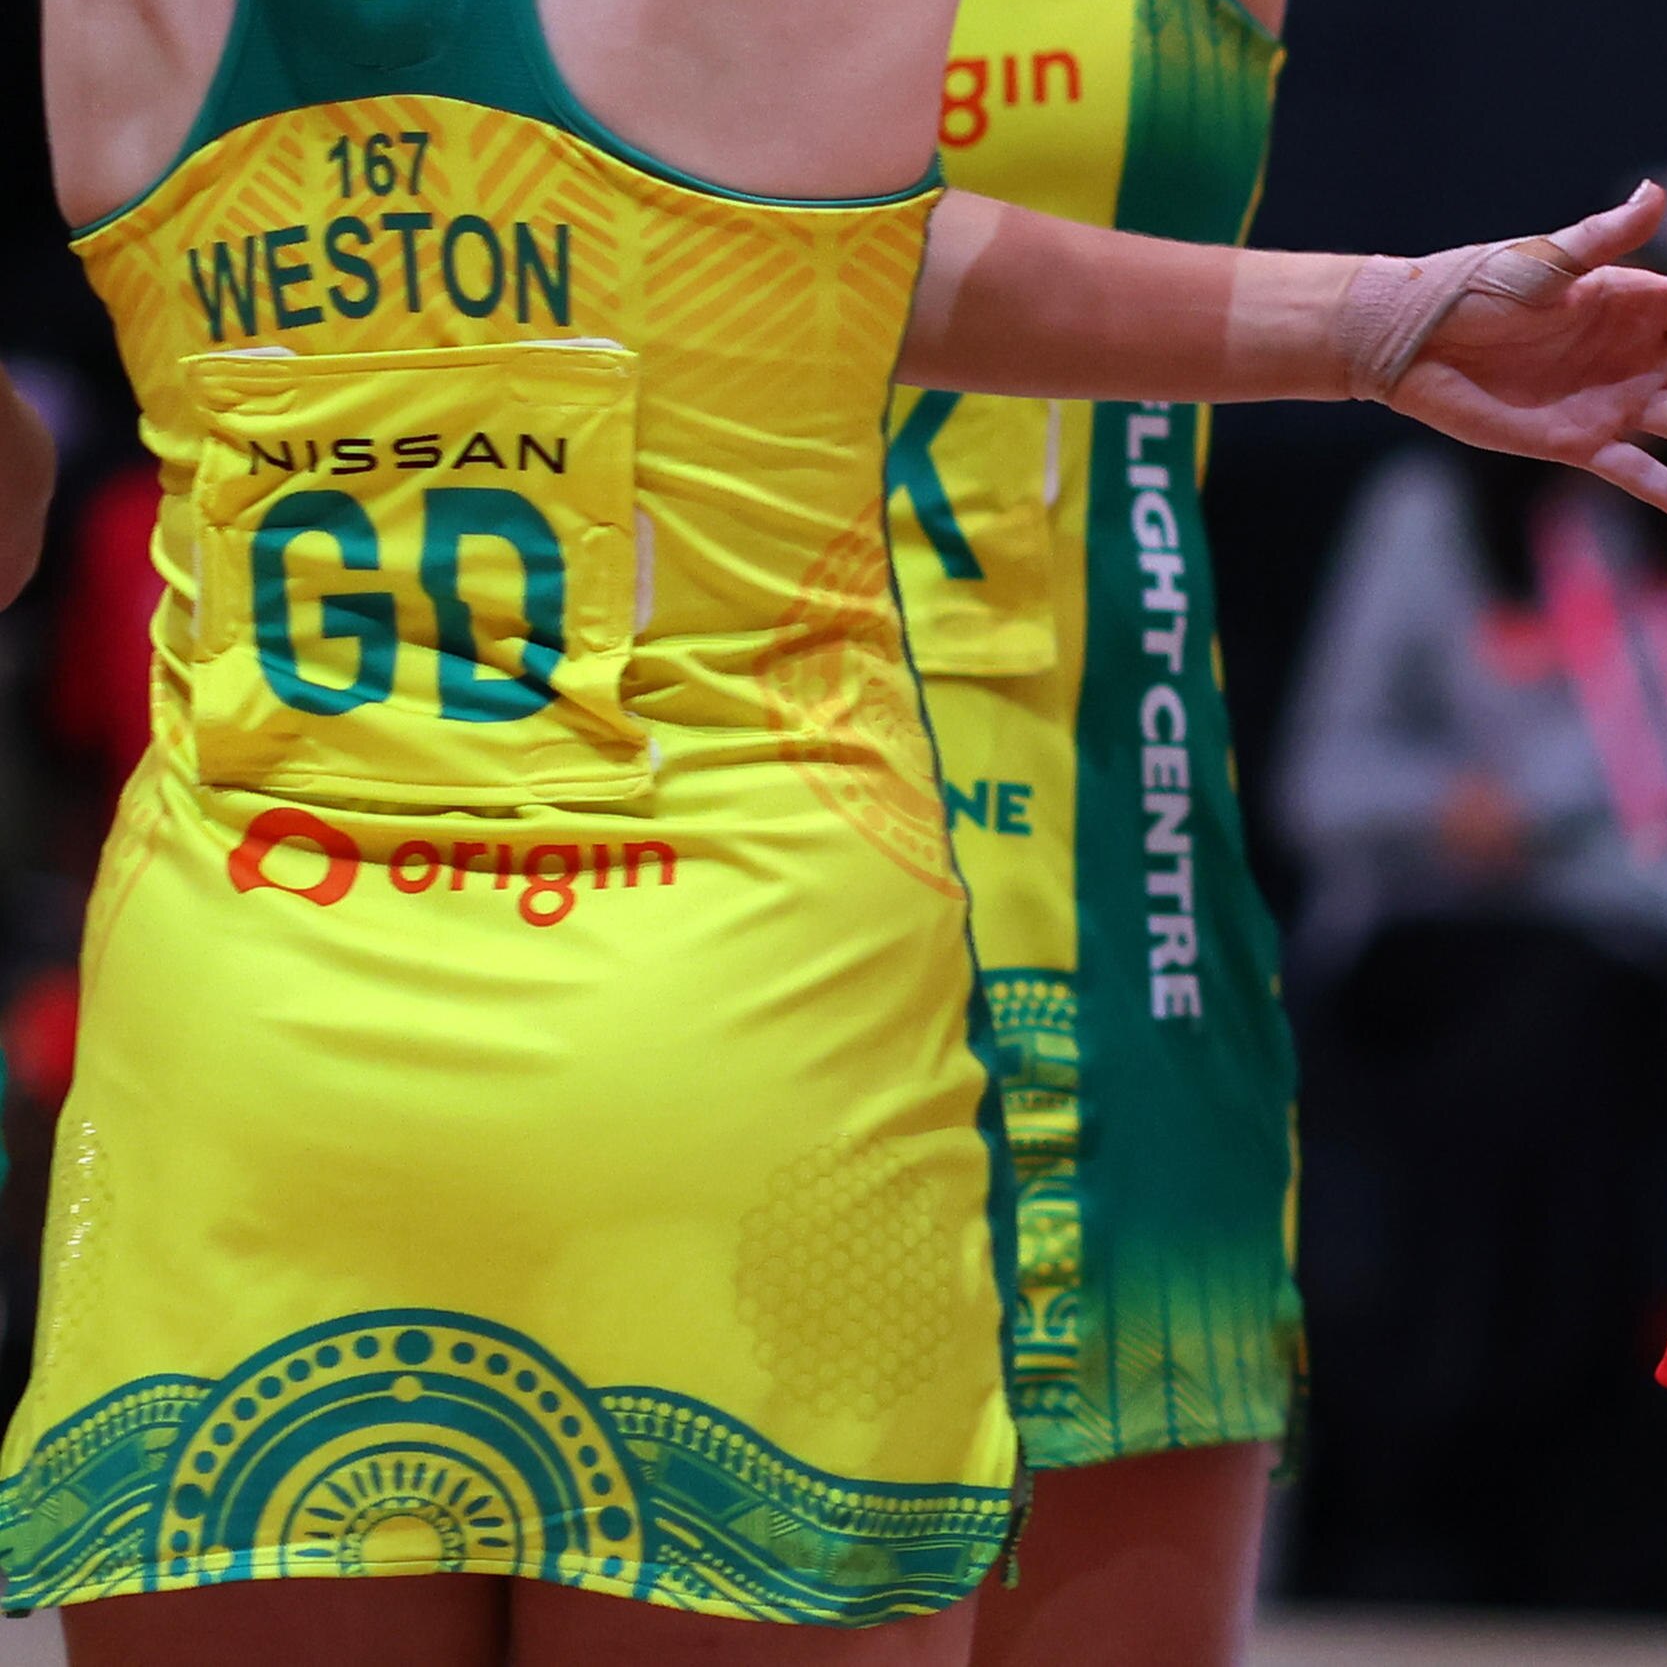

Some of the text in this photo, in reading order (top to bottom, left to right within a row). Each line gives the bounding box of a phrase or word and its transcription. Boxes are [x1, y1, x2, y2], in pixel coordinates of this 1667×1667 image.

[327, 132, 429, 197] 167
[188, 212, 571, 343] WESTON
[249, 431, 567, 476] NISSAN
[250, 486, 567, 723] GD
[1126, 400, 1201, 1020] LIGHT CENTRE
[388, 838, 677, 926] origin
